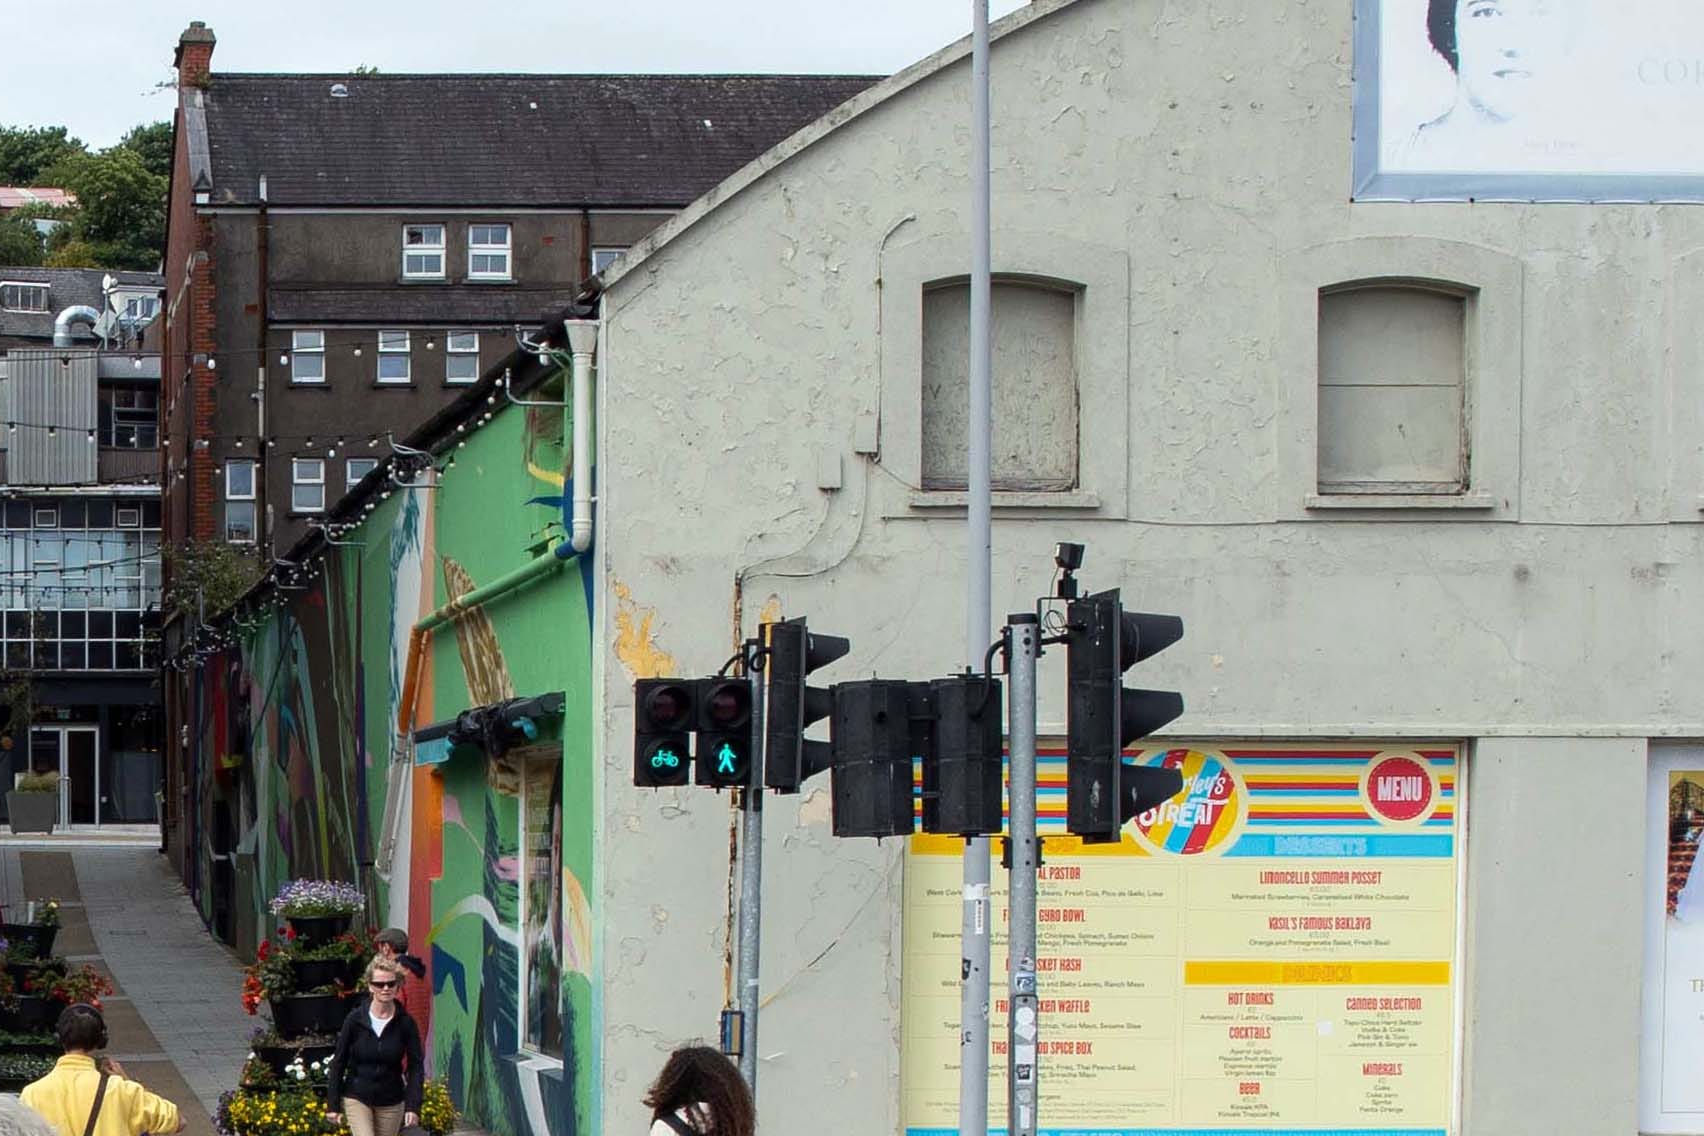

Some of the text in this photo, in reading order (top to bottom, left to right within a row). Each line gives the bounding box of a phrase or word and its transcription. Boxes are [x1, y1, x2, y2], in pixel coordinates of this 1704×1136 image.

[1377, 776, 1423, 801] MENU
[1311, 871, 1349, 884] SUMMER
[1351, 871, 1382, 884] POSSET
[1063, 909, 1085, 922] BOWL
[1299, 917, 1333, 930] FAMOUS
[1228, 992, 1243, 1005] HOT
[1058, 1000, 1090, 1013] WAFFLE
[1229, 1026, 1271, 1039] COCKTAILS
[1051, 1042, 1074, 1055] SPICE
[1076, 1042, 1092, 1055] BOX
[1239, 1082, 1260, 1095] BEER
